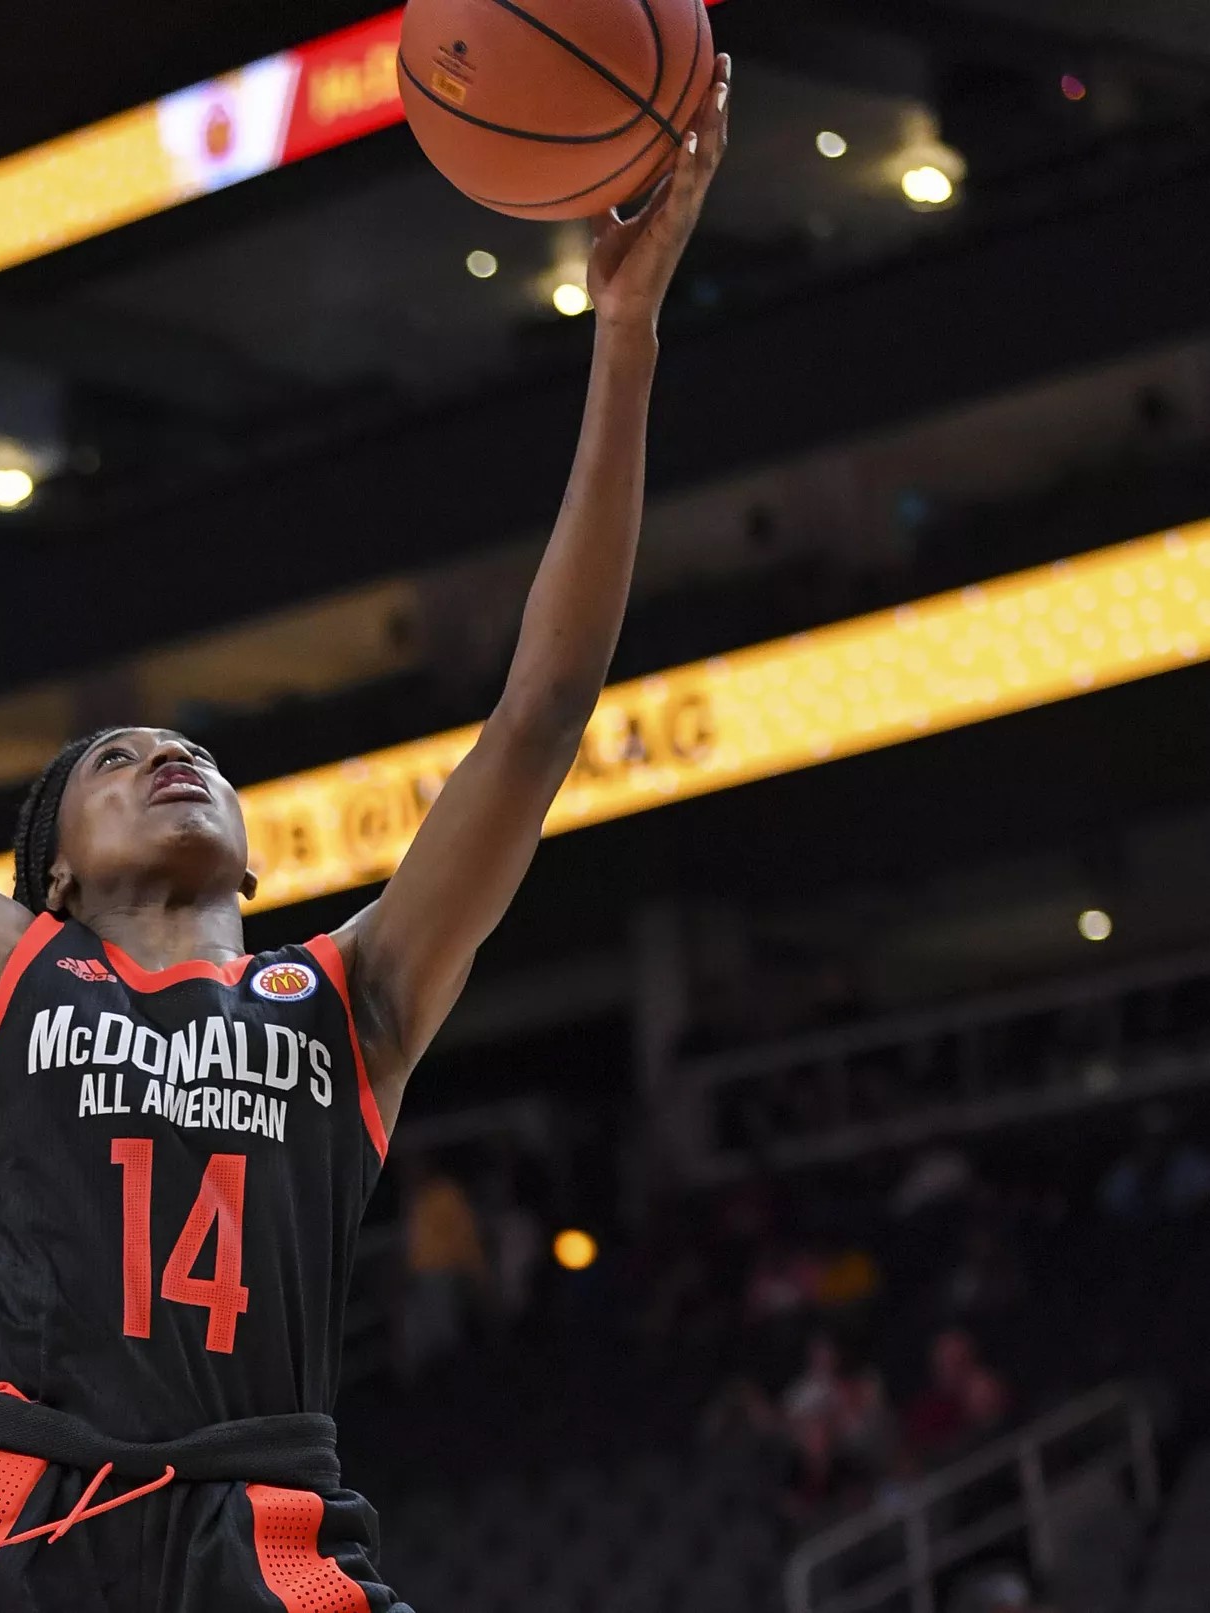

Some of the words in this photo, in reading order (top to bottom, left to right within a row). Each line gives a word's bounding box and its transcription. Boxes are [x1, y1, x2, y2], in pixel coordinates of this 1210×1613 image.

[56, 957, 118, 983] adidas
[78, 1072, 131, 1118] ALL
[141, 1079, 288, 1143] AMERICAN
[110, 1137, 250, 1355] 14
